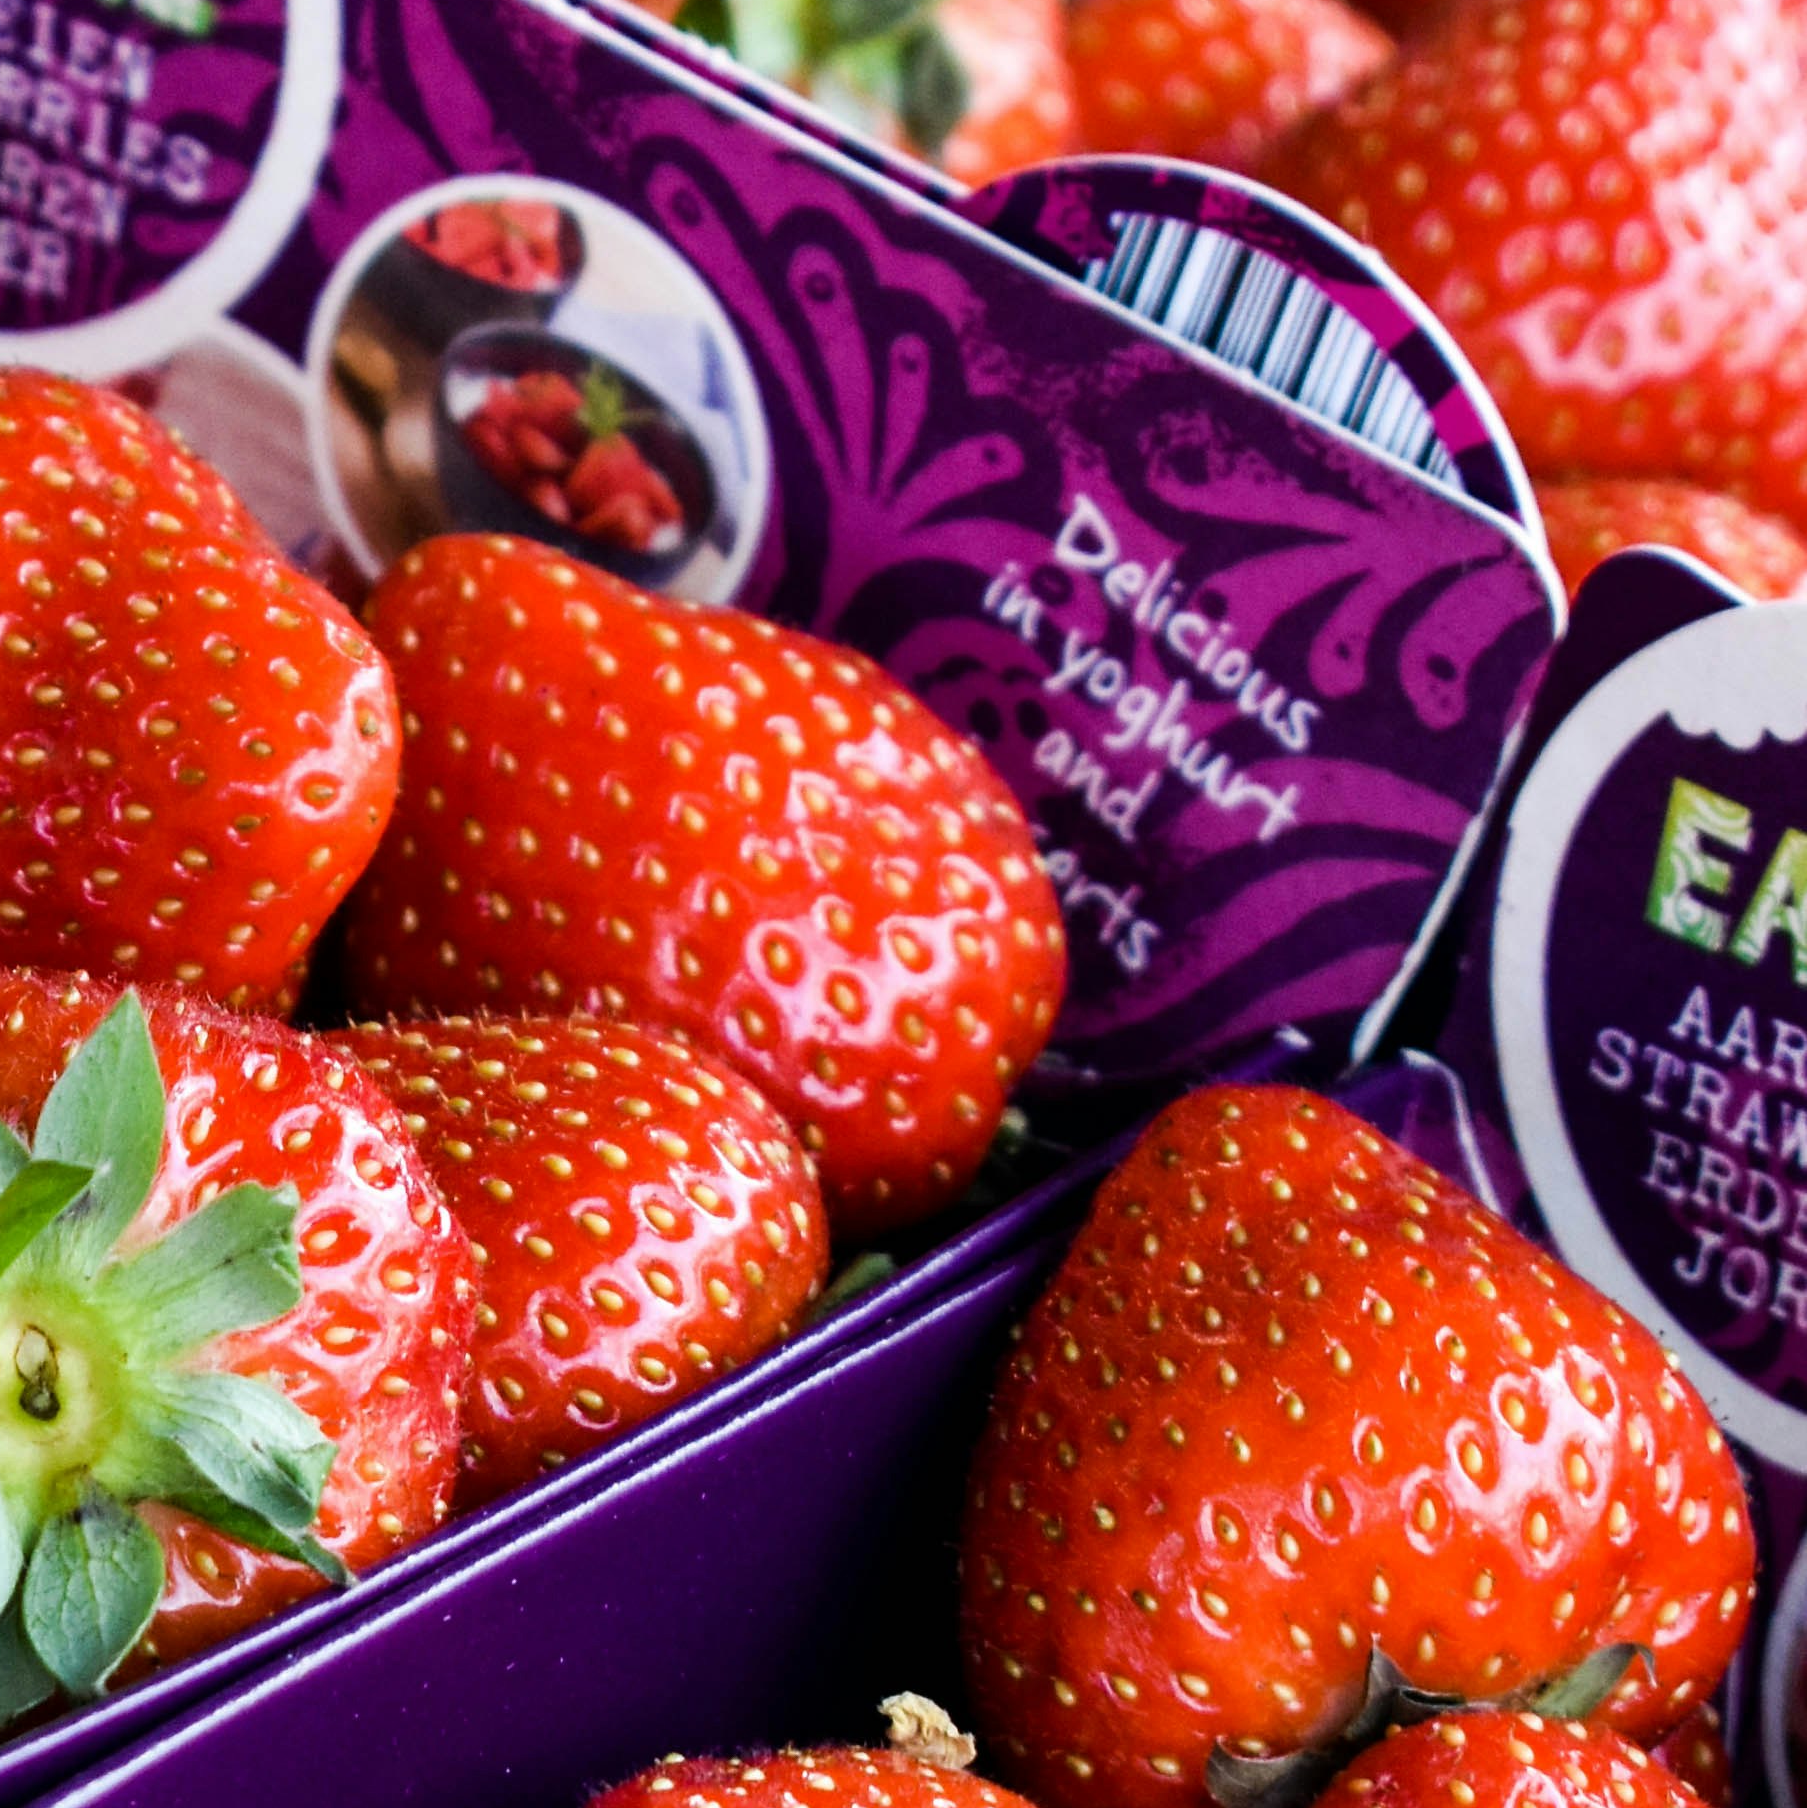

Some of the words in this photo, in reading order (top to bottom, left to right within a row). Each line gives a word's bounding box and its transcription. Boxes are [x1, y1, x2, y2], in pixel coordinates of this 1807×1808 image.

[983, 563, 1041, 642] in
[1044, 629, 1299, 843] yoghurt
[1055, 492, 1324, 753] Delicious
[1033, 729, 1160, 842] and
[1032, 823, 1161, 971] erts
